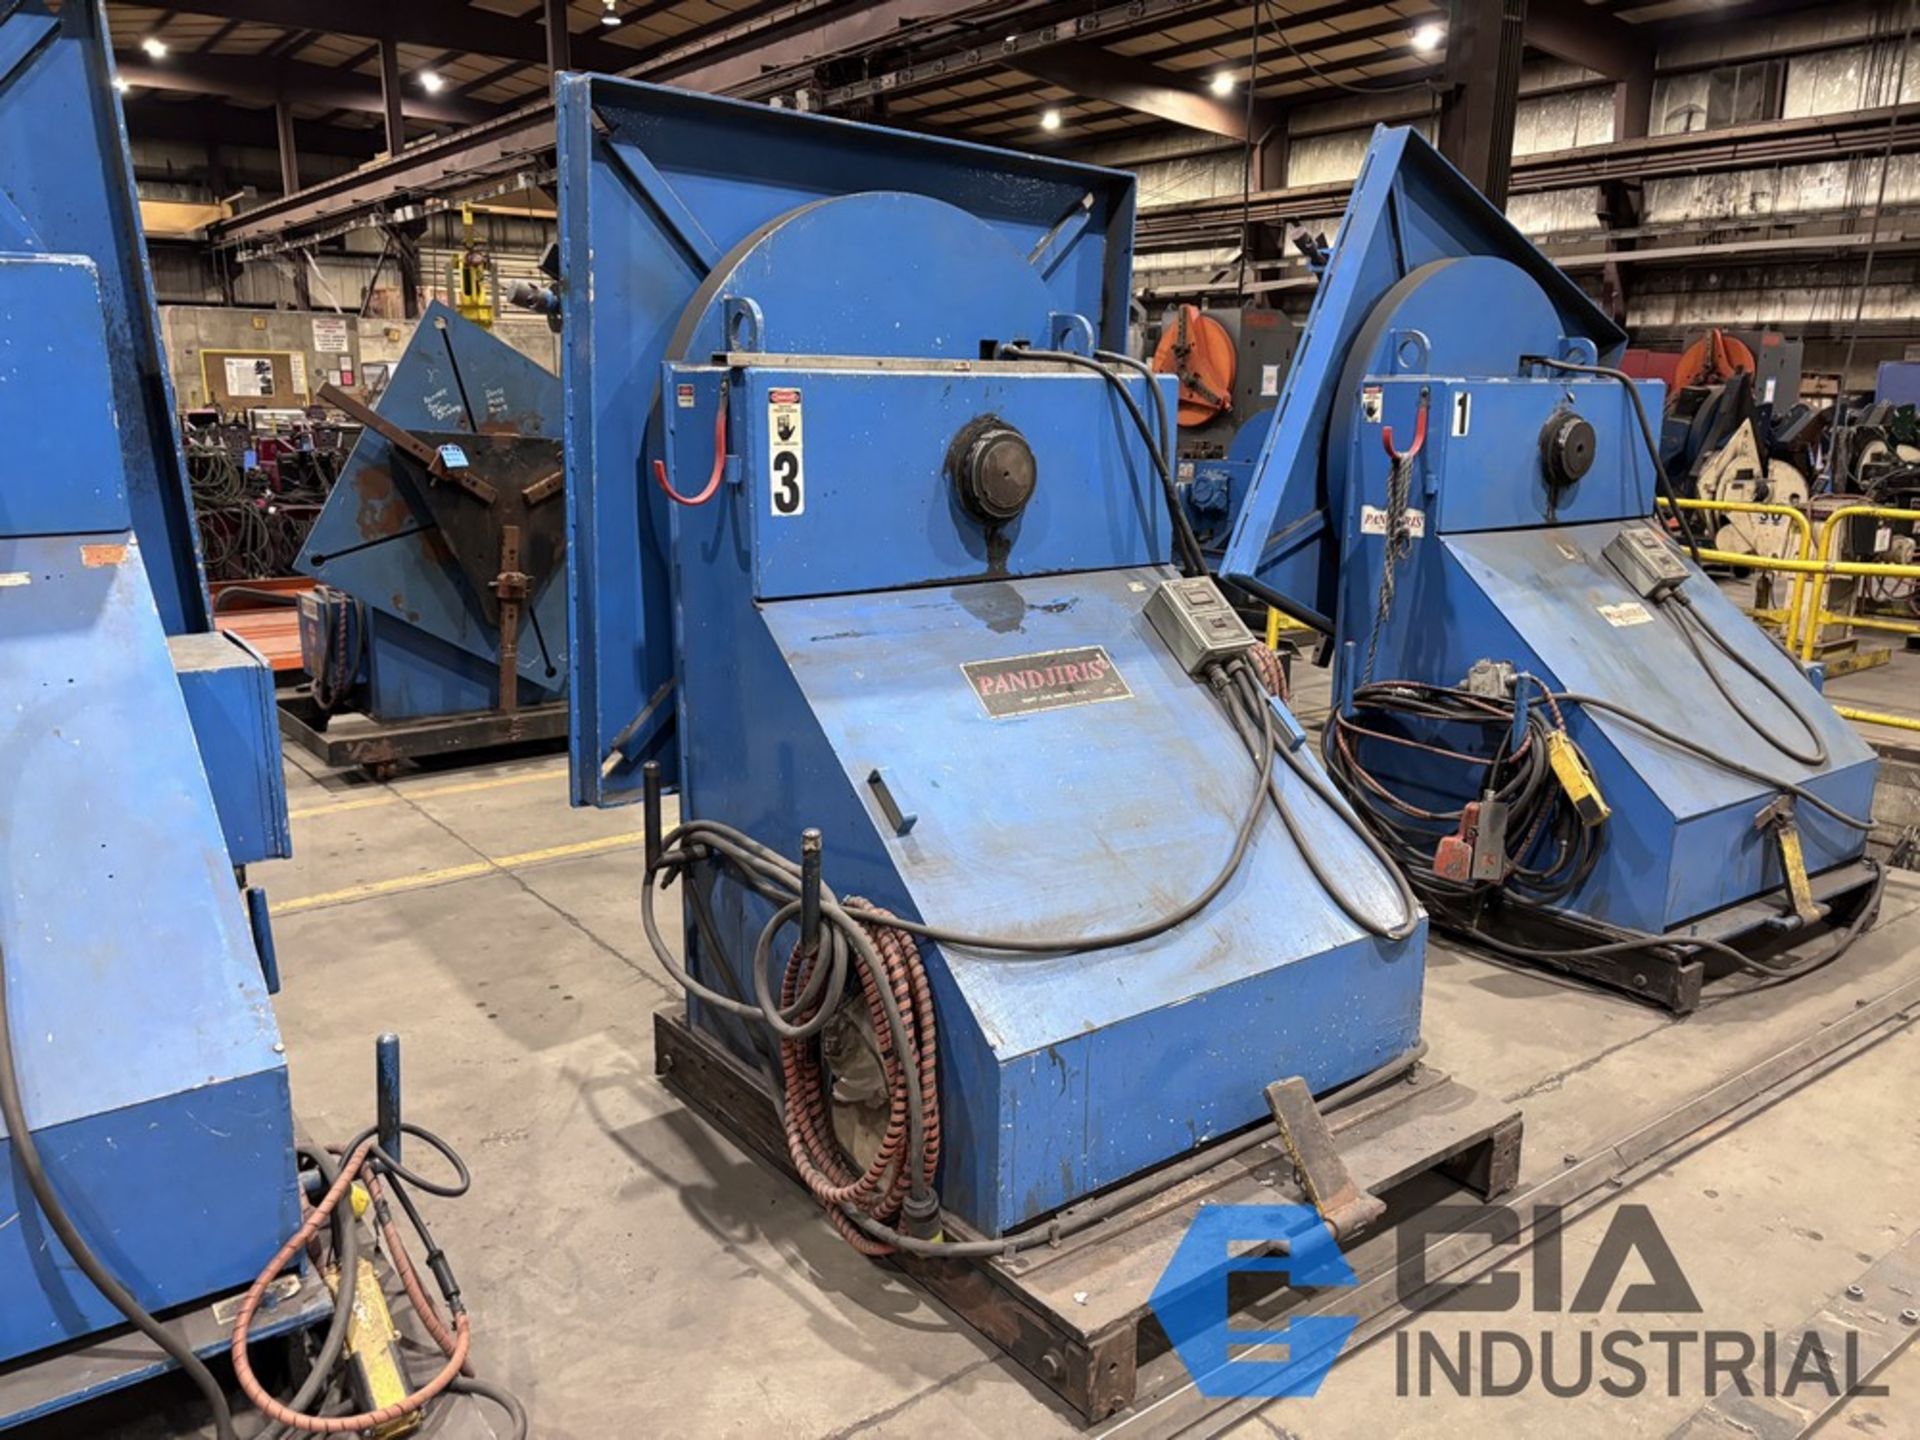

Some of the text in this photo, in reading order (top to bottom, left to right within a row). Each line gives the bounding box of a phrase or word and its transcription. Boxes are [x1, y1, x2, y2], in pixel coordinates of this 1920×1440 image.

[1457, 392, 1468, 435] 1
[773, 450, 800, 514] 3
[977, 660, 1105, 696] PANDJIRIS
